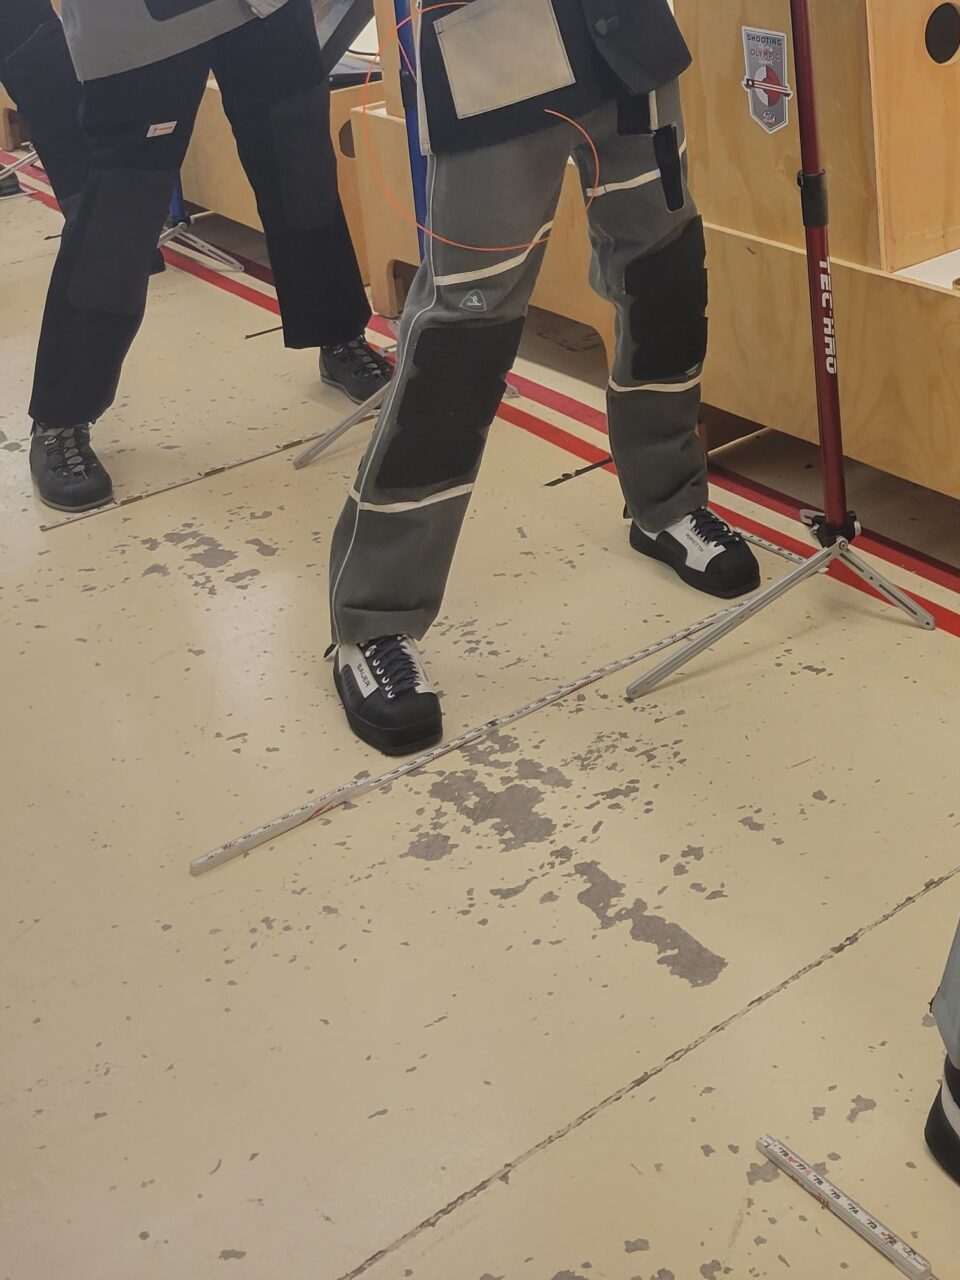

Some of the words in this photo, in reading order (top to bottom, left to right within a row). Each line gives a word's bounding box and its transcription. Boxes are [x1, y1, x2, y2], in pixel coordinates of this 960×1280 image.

[746, 33, 782, 47] SHOOTING
[750, 48, 780, 61] OLYMPIC
[357, 663, 370, 688] SAUER
